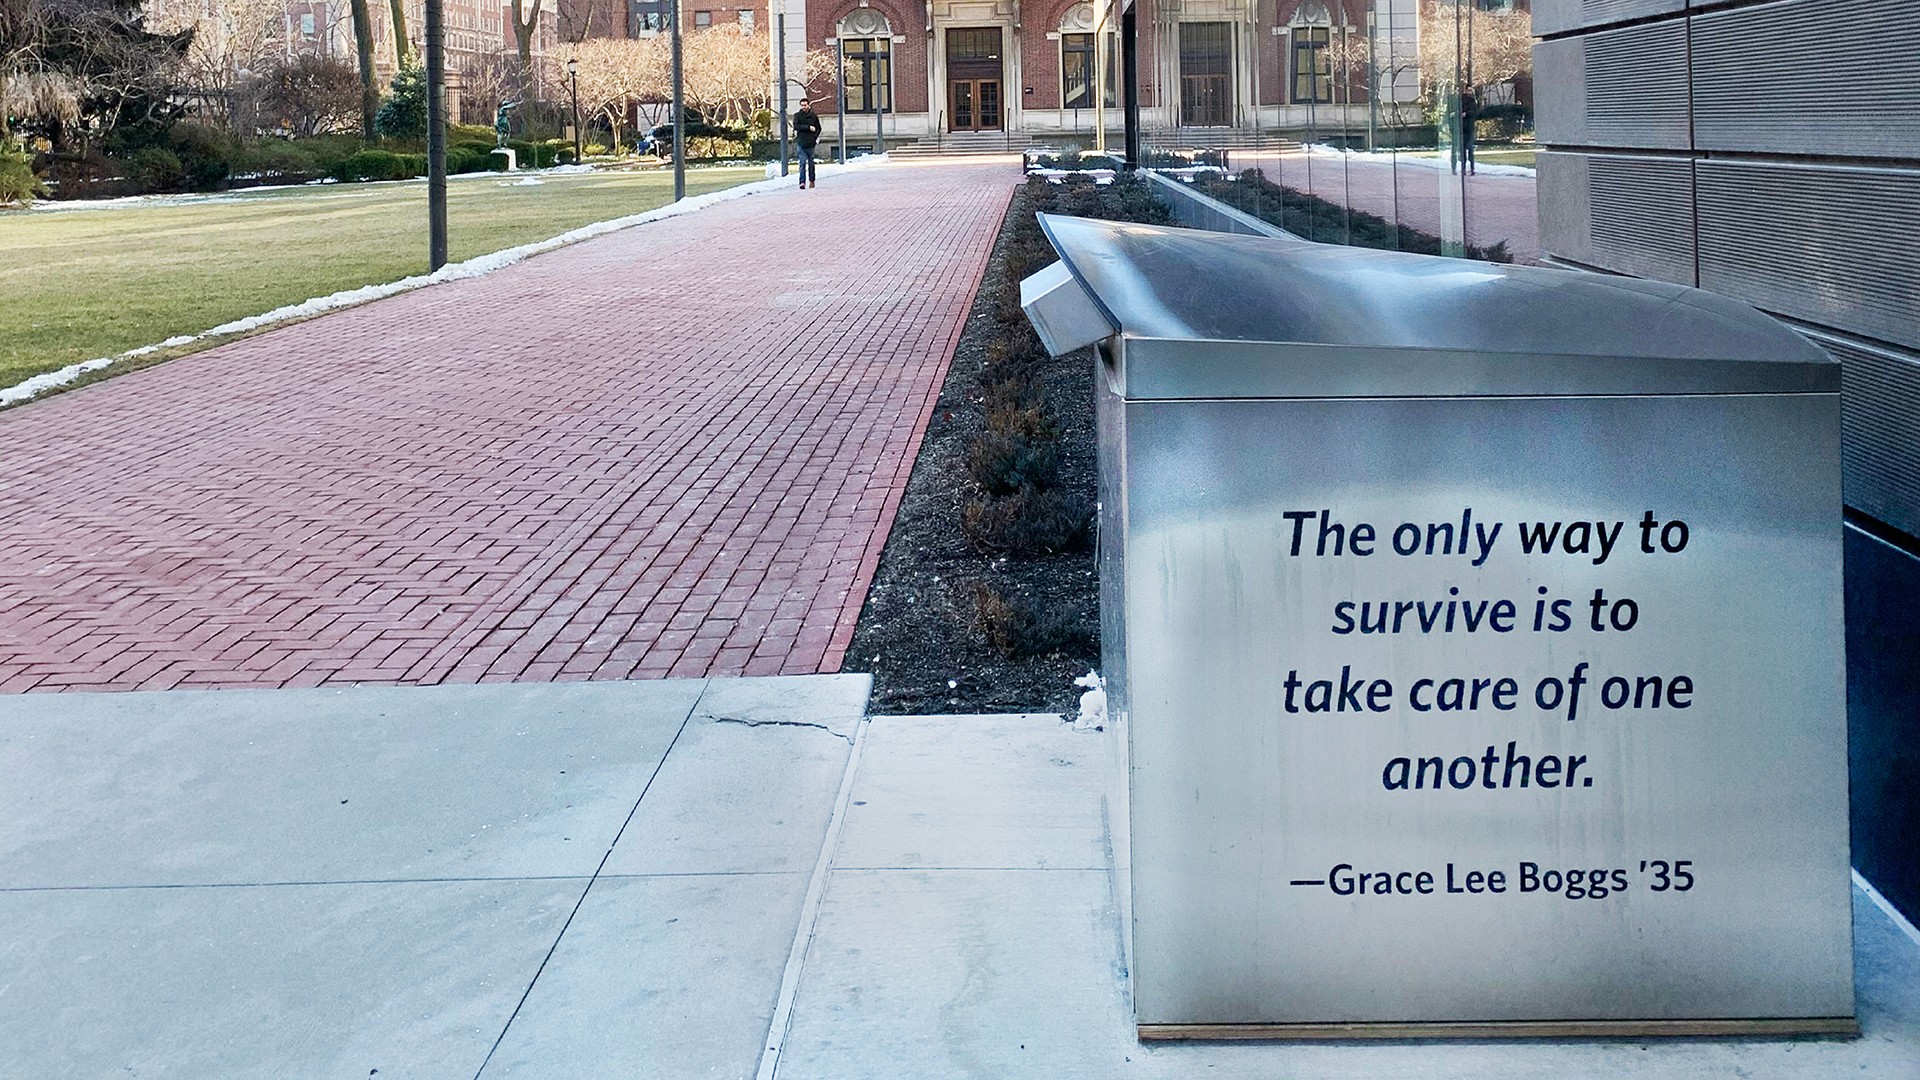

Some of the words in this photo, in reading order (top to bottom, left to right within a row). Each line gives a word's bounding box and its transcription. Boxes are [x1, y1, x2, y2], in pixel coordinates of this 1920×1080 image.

[1281, 509, 1376, 557] The
[1392, 507, 1504, 567] only
[1518, 521, 1625, 567] way
[1639, 509, 1690, 554] to
[1331, 586, 1516, 635] survive
[1533, 585, 1572, 633] is
[1589, 588, 1639, 632] to
[1283, 664, 1393, 714] take
[1409, 678, 1519, 712] care
[1534, 662, 1589, 722] of
[1601, 675, 1694, 710] one
[1382, 740, 1594, 791] another.
[1446, 862, 1507, 894] Lee
[1519, 861, 1629, 900] Boggs
